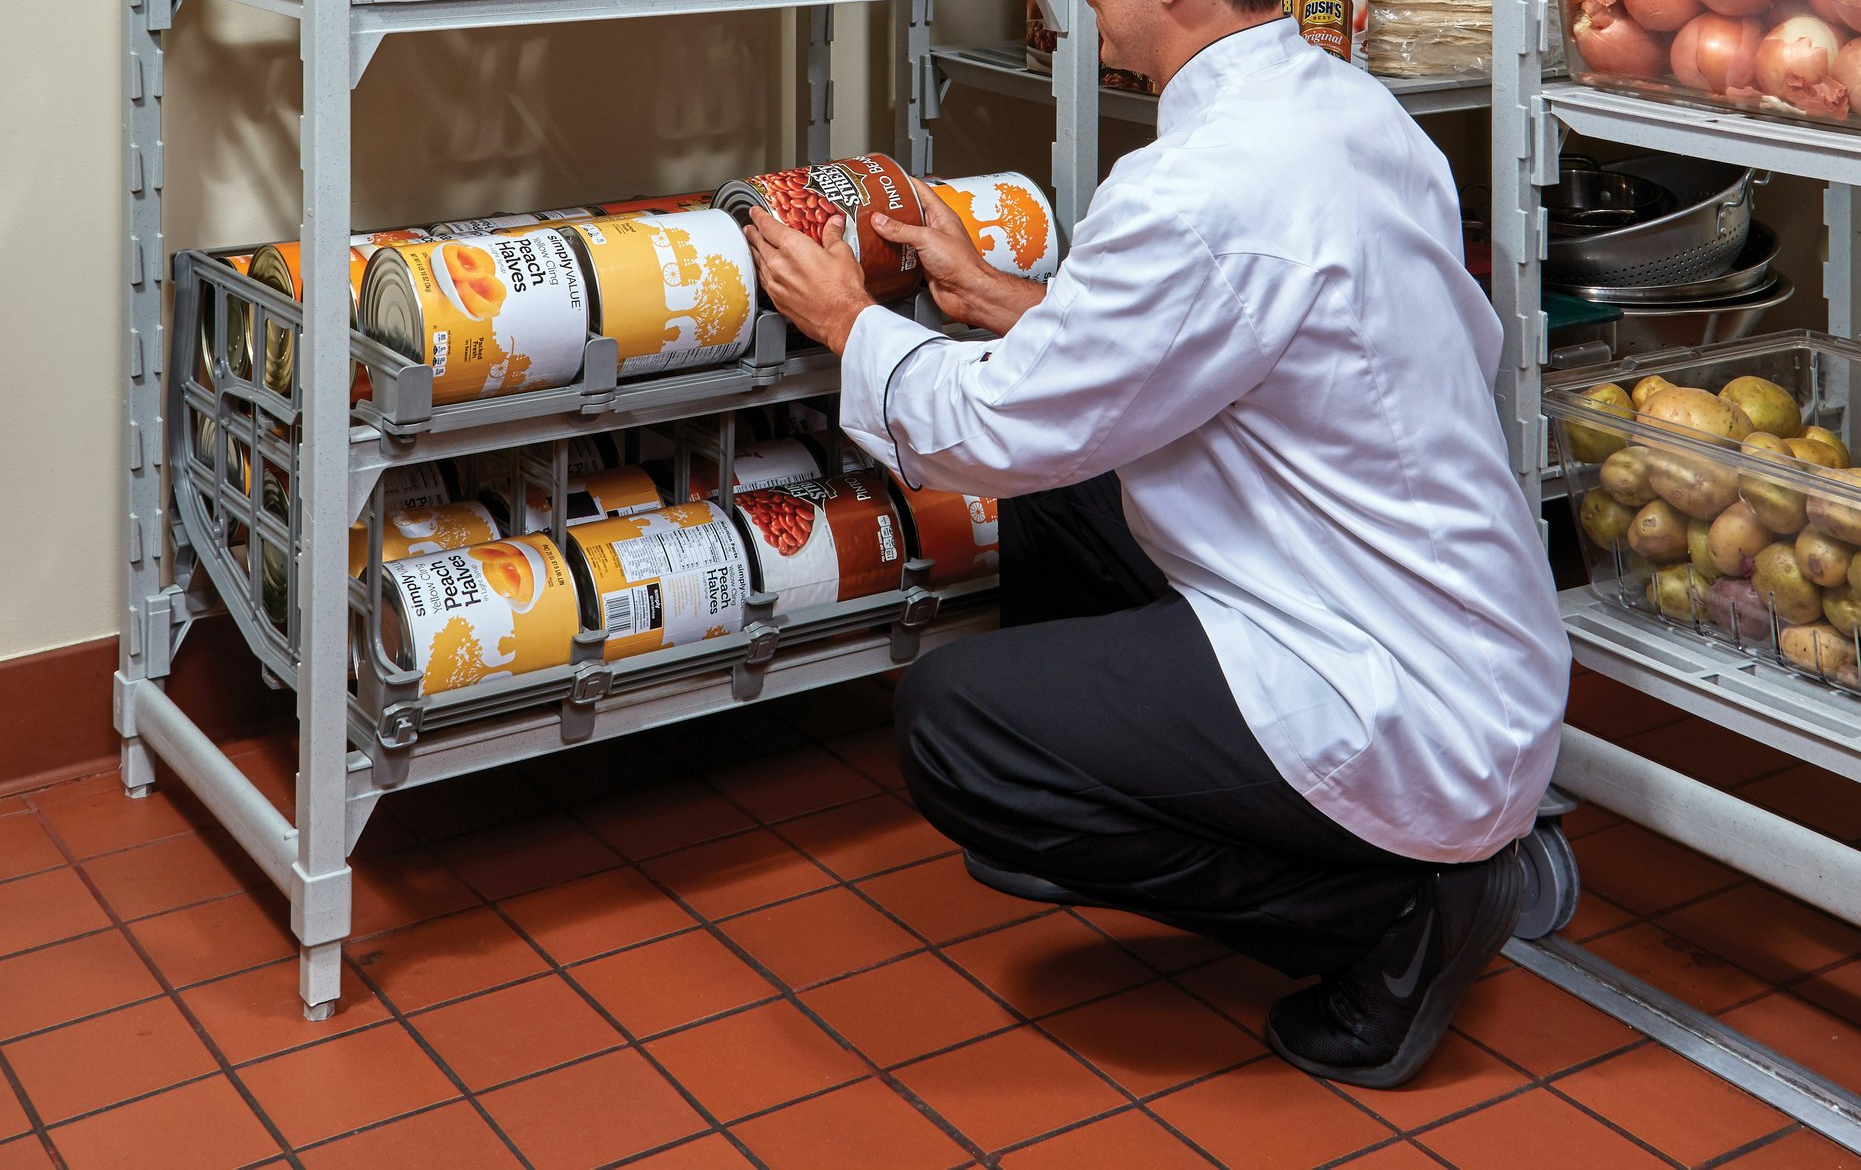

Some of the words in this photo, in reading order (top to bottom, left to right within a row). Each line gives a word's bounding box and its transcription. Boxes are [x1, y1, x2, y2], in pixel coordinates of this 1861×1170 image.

[1304, 0, 1342, 19] BUSH'S
[809, 171, 843, 202] FIRST
[817, 166, 860, 207] STREET
[879, 176, 903, 209] PINTO
[495, 241, 526, 293] Halves
[514, 239, 546, 286] Peach
[533, 237, 549, 258] Yellow
[546, 260, 558, 285] Cling
[548, 235, 573, 270] simply
[566, 270, 581, 308] VALUE
[845, 477, 871, 501] PINTO
[415, 563, 431, 581] Cling
[430, 560, 462, 611] Peach
[448, 555, 481, 607] Halves
[707, 569, 719, 615] Halves
[718, 567, 731, 610] Peach
[737, 564, 746, 590] simply
[402, 575, 426, 617] simply
[428, 582, 442, 615] Yellow
